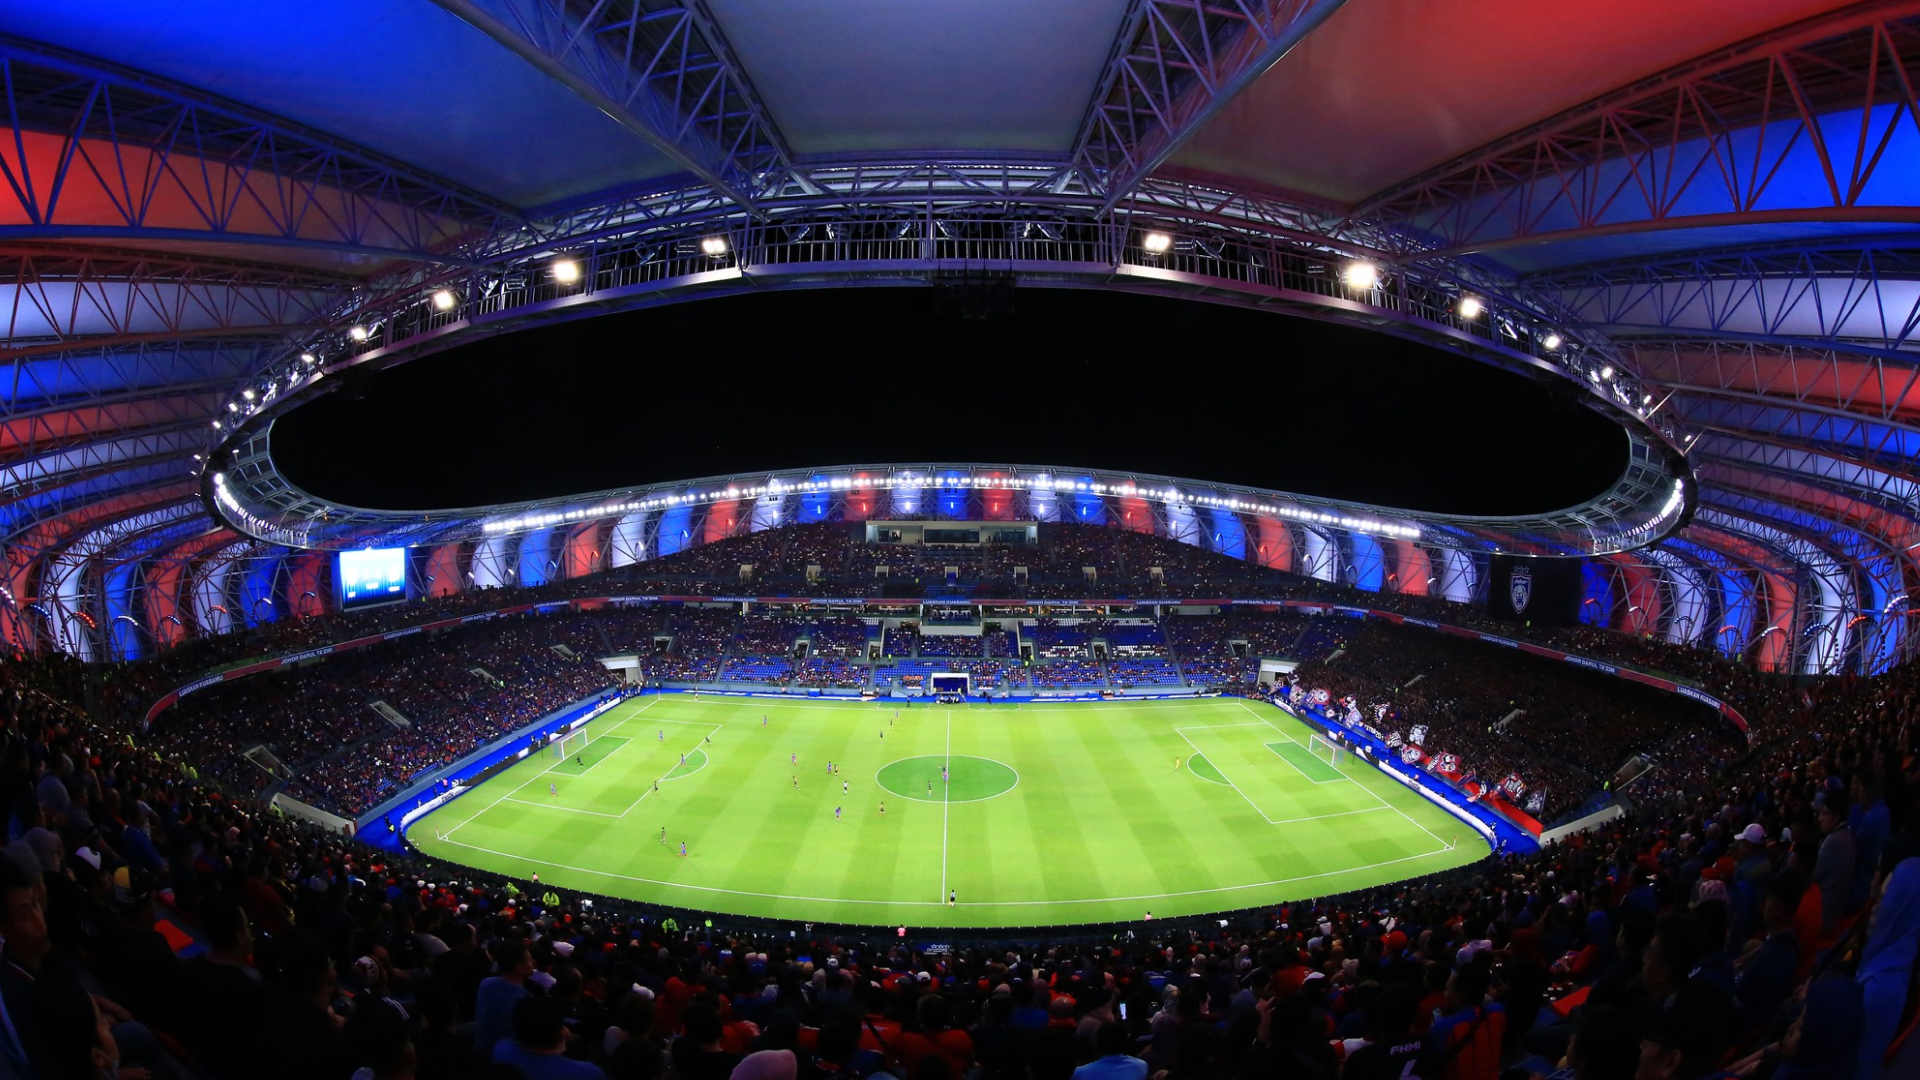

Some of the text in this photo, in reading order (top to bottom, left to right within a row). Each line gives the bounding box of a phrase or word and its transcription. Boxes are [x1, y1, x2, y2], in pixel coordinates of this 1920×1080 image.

[281, 656, 299, 665] JOHOR
[1564, 656, 1582, 664] JOHOR
[1581, 659, 1598, 669] DARUL
[179, 675, 224, 697] LUASKAN KUASAMU
[1677, 686, 1720, 709] LUASKAN KUASAMU
